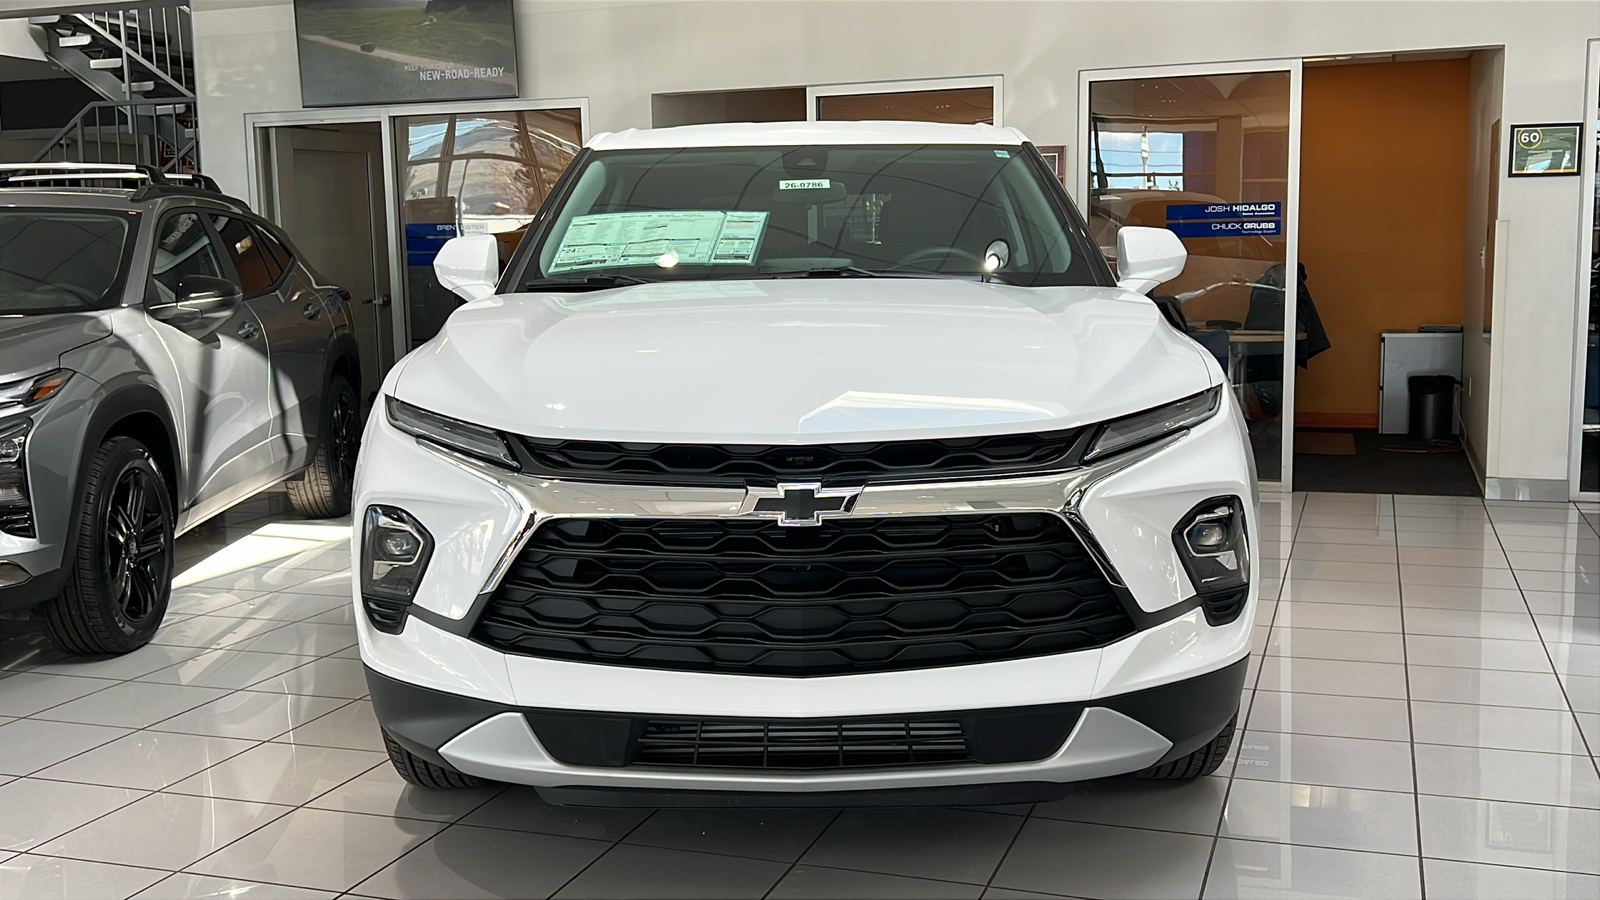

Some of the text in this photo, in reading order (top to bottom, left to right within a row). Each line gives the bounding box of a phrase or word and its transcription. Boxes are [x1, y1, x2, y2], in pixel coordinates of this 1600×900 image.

[420, 67, 505, 81] NEW-ROAD-READY
[1520, 132, 1540, 143] 60
[784, 181, 824, 189] 26-0786
[1211, 222, 1242, 230] CHUCK
